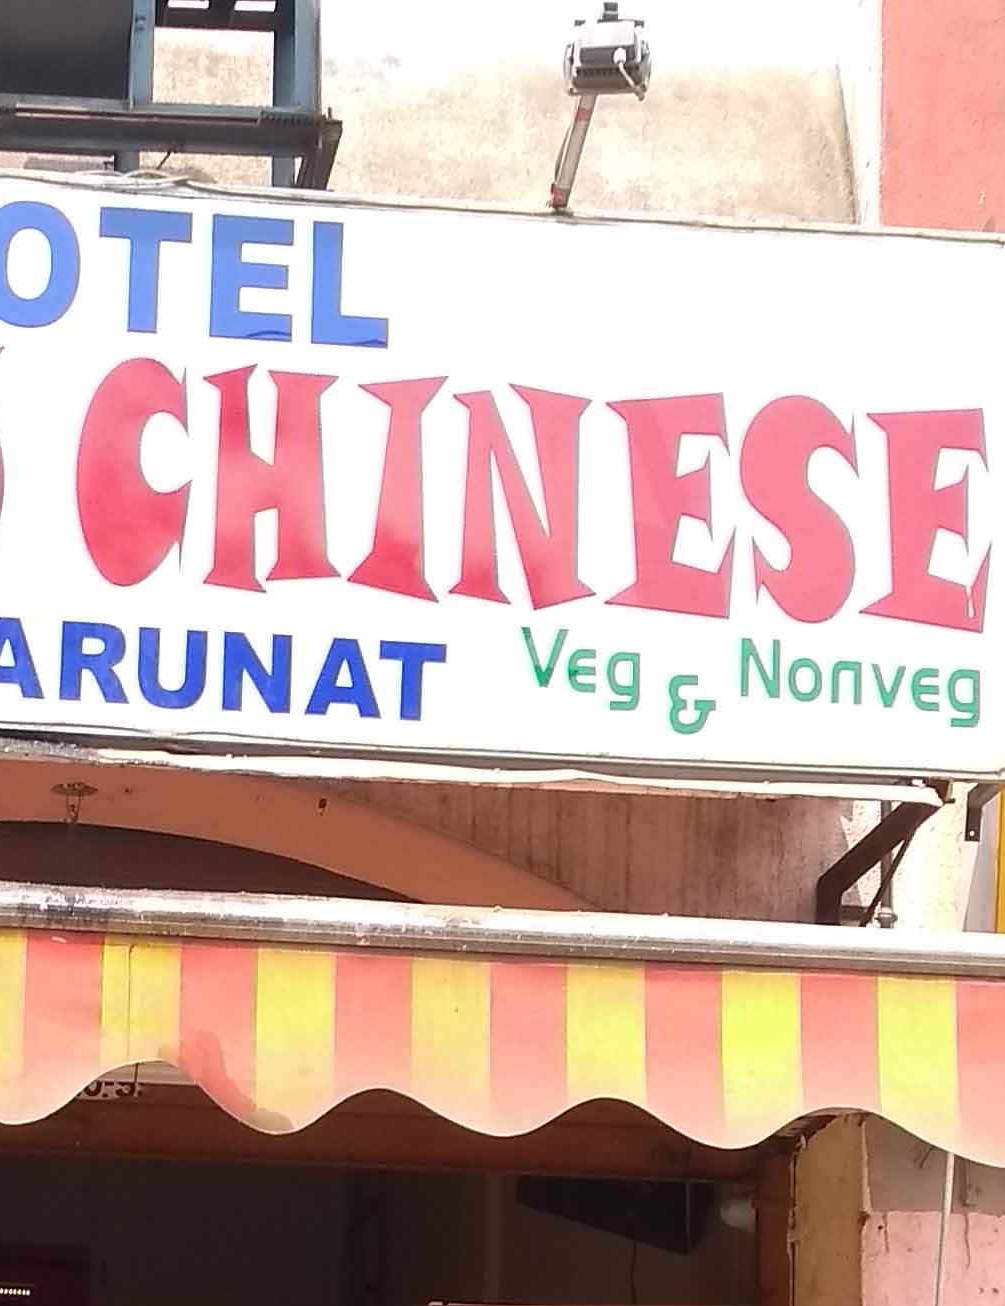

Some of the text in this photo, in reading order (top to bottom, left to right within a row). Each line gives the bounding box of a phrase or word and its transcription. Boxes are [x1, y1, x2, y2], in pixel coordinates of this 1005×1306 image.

[75, 356, 992, 634] CHINESE
[520, 626, 981, 735] Veg & Nonveg
